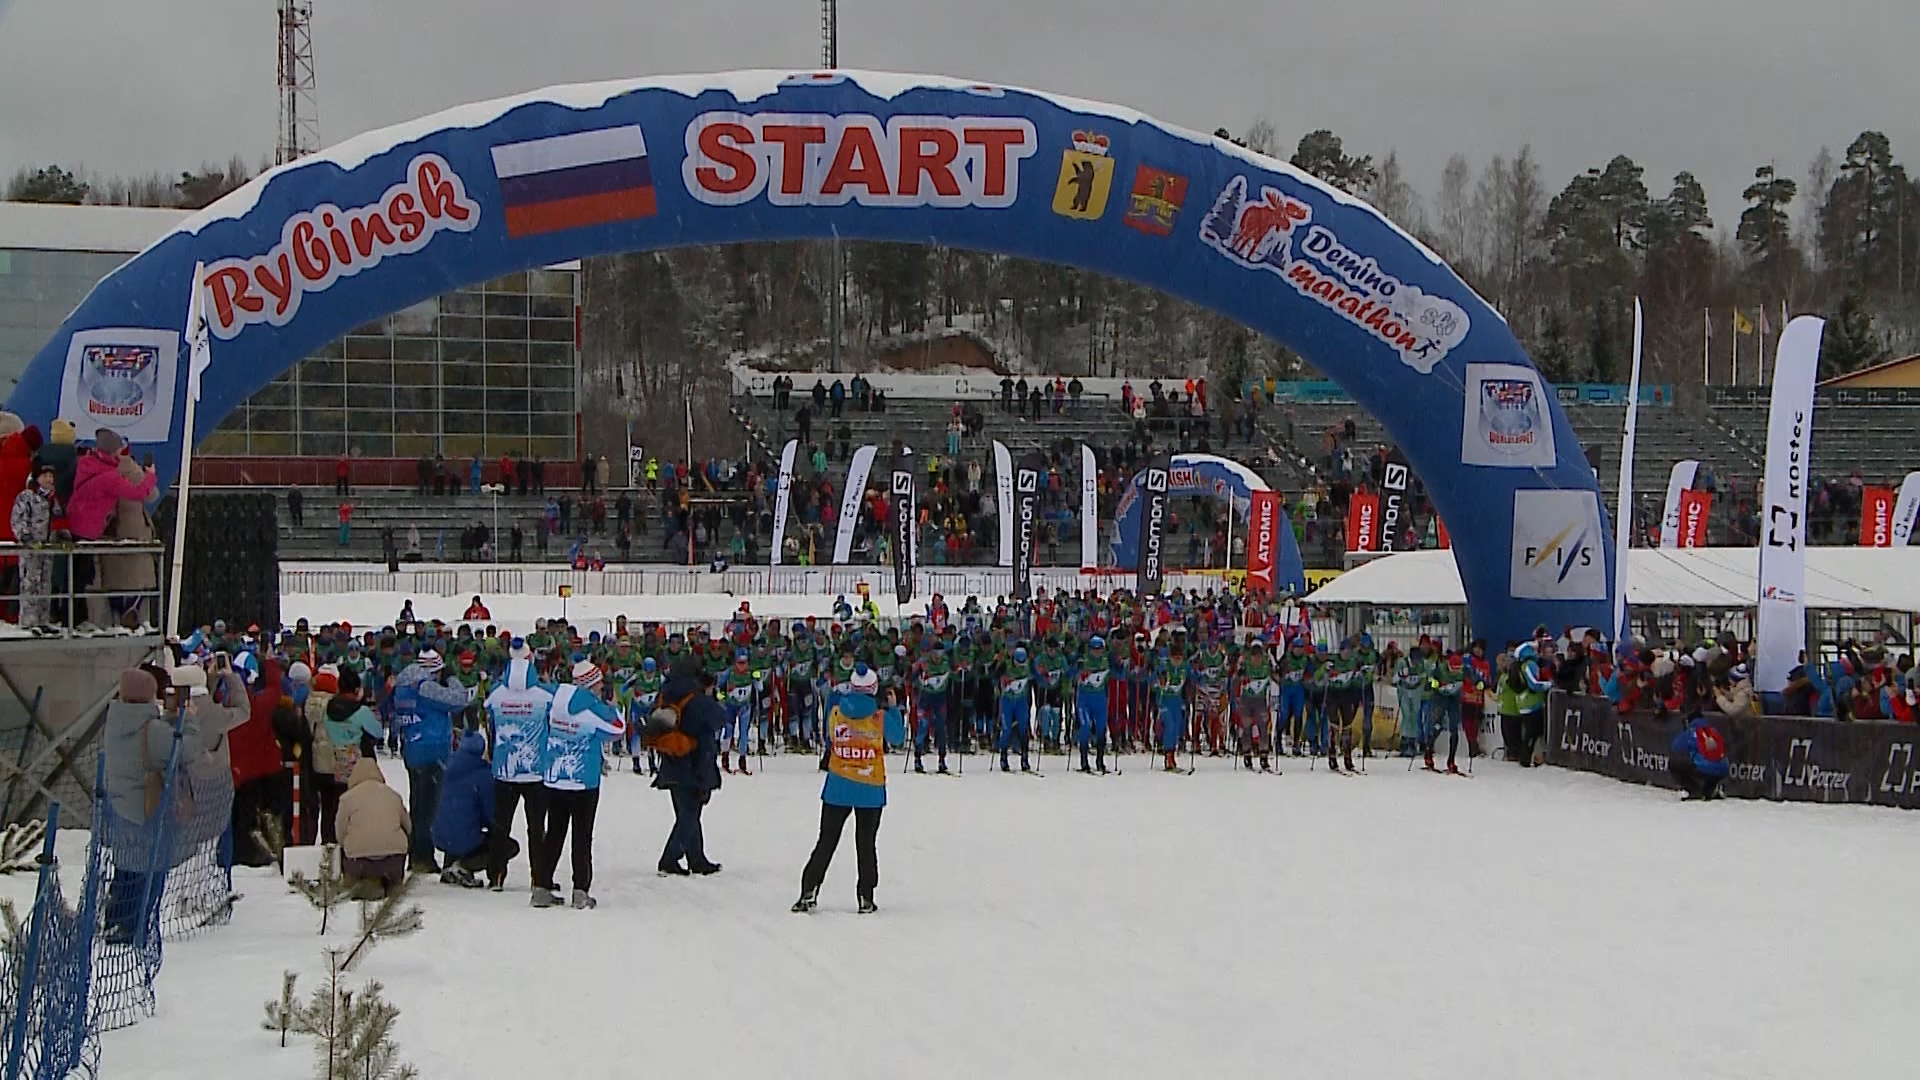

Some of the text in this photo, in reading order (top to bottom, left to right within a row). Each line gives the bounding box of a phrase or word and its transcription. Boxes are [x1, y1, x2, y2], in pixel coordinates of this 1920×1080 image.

[695, 122, 1025, 196] START
[203, 161, 470, 328] Rybinsk
[1306, 230, 1396, 297] Demino
[1287, 264, 1417, 352] marathon
[1019, 496, 1034, 583] salomon
[1146, 495, 1163, 580] salomon
[1257, 499, 1272, 564] ATOMIC
[834, 746, 876, 759] MEDIA
[1636, 746, 1670, 772] Ростех
[1729, 762, 1766, 782] остех
[1808, 764, 1851, 790] Ростех
